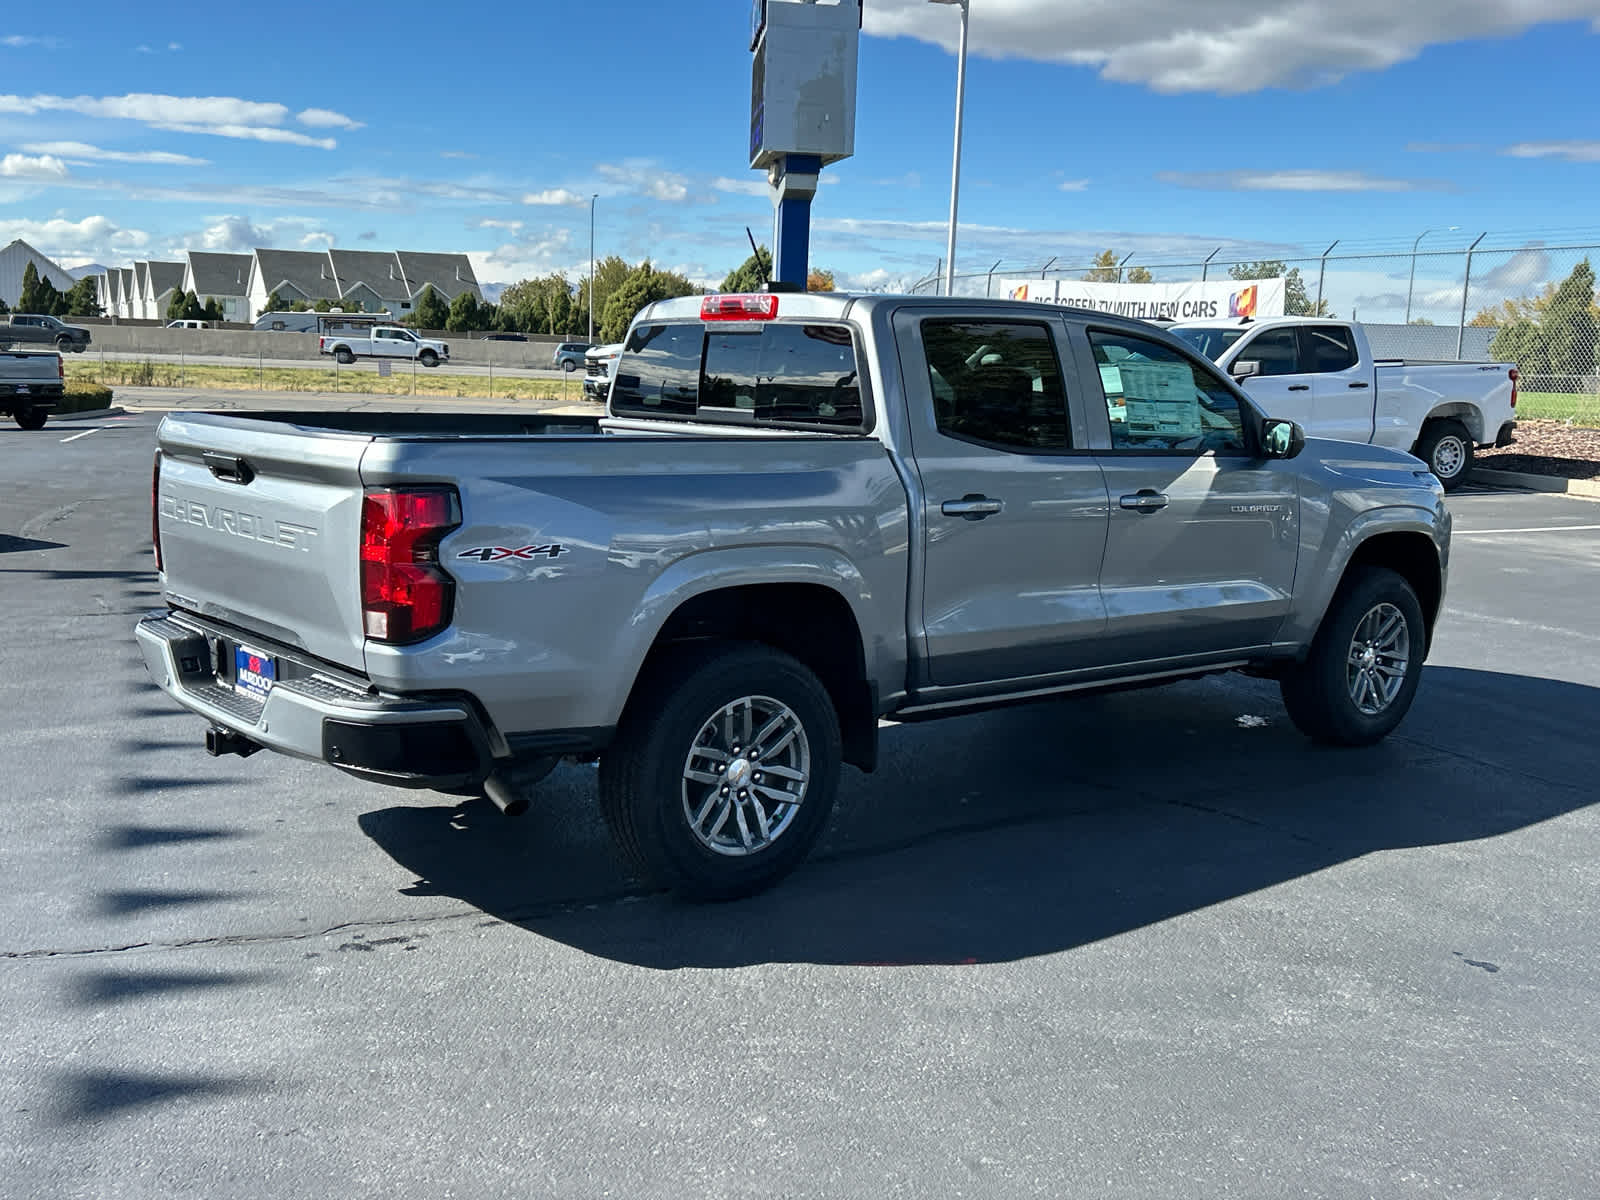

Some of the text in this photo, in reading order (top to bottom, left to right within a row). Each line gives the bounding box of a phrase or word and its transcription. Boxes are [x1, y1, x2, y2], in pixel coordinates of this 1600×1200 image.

[1114, 301, 1146, 319] WITH
[1149, 301, 1179, 318] NEW
[1182, 300, 1217, 318] CARS
[160, 494, 318, 552] CHEVROLET
